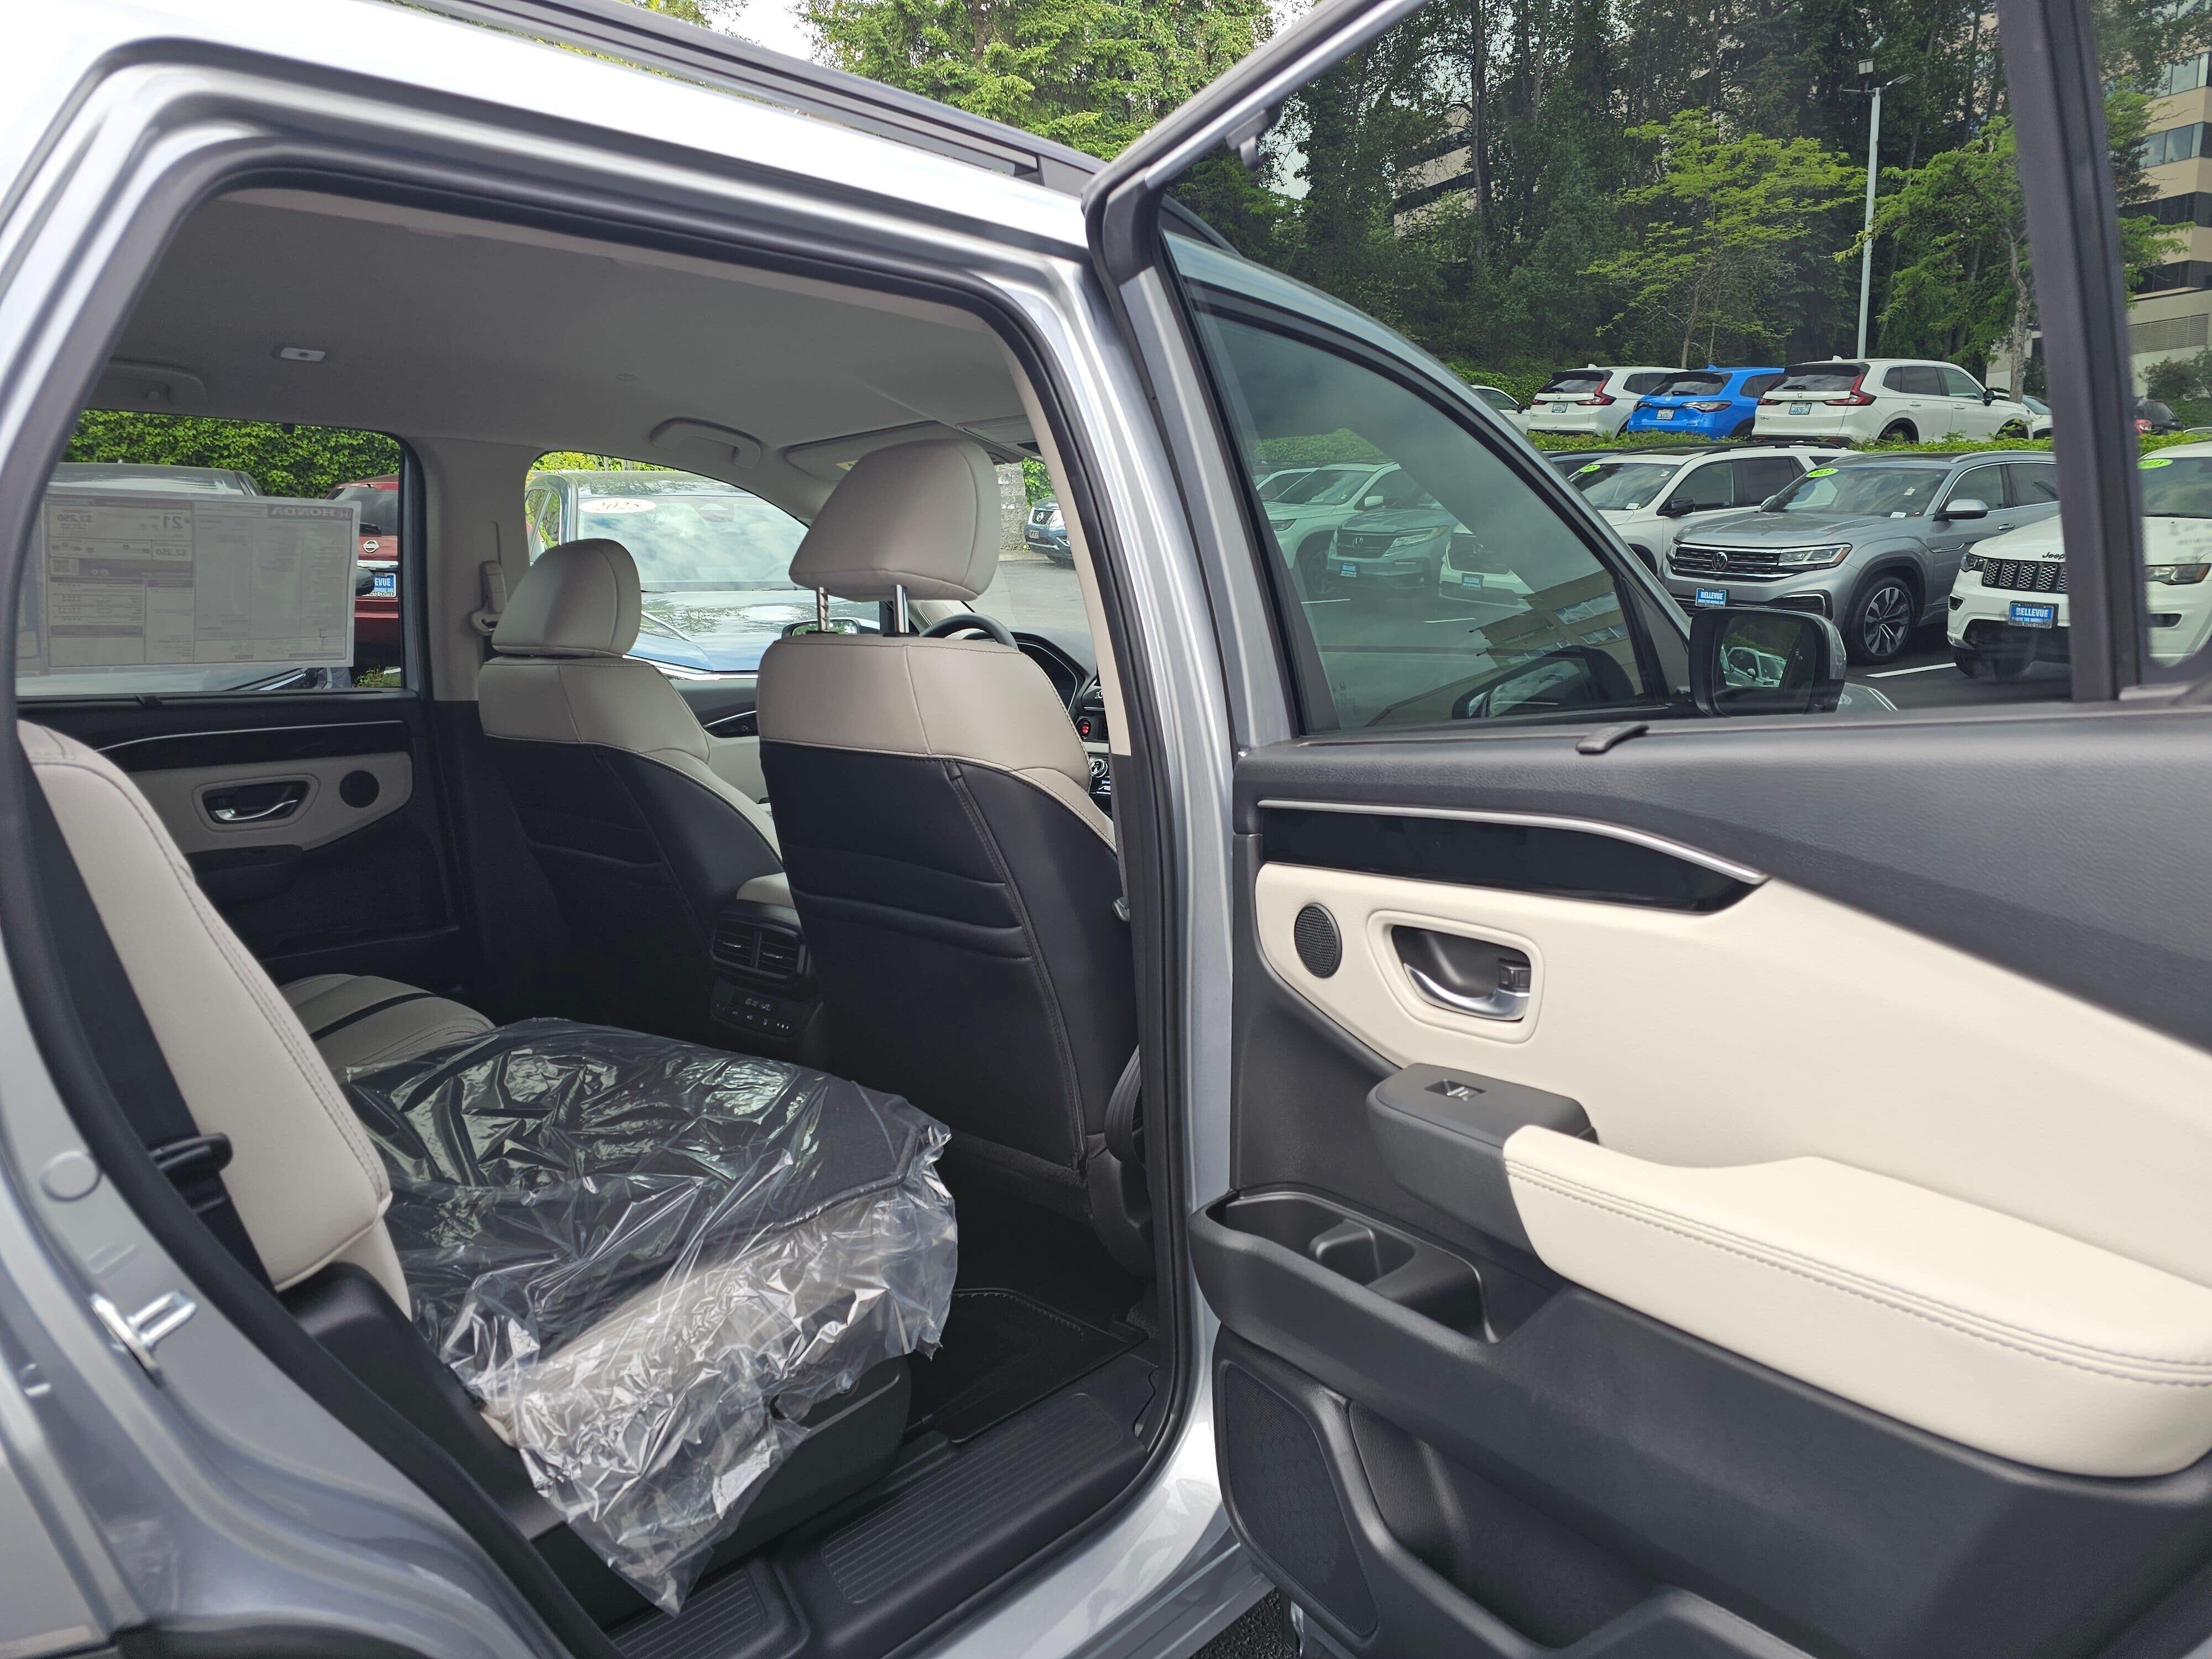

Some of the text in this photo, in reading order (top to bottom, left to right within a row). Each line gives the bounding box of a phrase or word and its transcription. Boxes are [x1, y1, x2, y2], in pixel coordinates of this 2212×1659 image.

[2042, 552, 2065, 560] Jeep
[374, 578, 391, 587] EVUE
[1700, 591, 1723, 600] BELLEVUE
[2016, 607, 2049, 618] BELLEVUE
